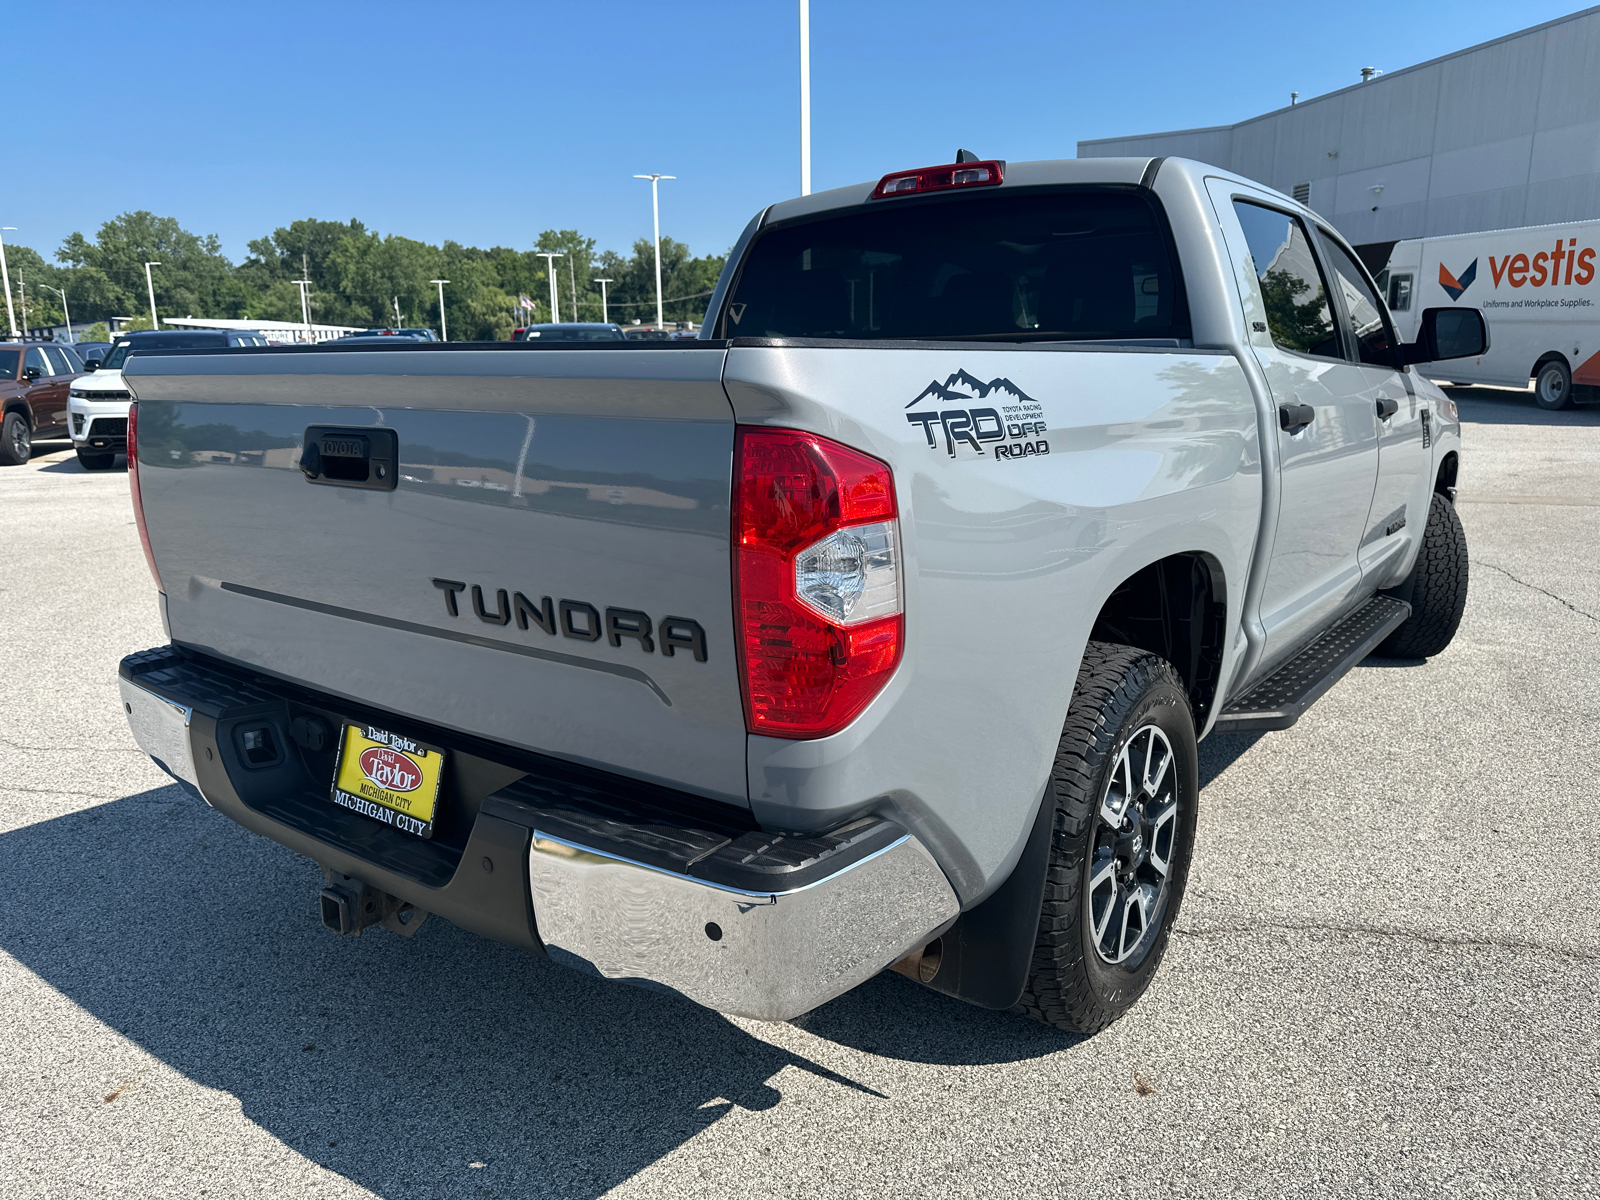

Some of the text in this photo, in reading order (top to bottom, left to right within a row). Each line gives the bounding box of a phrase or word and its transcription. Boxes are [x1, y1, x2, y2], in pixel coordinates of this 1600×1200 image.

[1488, 237, 1597, 290] vestis
[1482, 298, 1591, 310] Uniforms and Workplace Supplies
[1002, 404, 1042, 413] TOYOTA RACING
[1005, 412, 1044, 422] DEVELOPMENT
[905, 408, 1006, 458] TRD
[1007, 421, 1047, 439] OFF
[321, 441, 360, 455] TOYOTA
[994, 440, 1050, 461] ROAD
[430, 577, 708, 663] TUNDRA
[368, 726, 416, 753] David Taylor
[377, 749, 395, 763] David
[368, 757, 416, 790] Taylor
[359, 783, 412, 811] MICHIGAN CITY
[334, 790, 426, 836] MICHIGAN CITY
